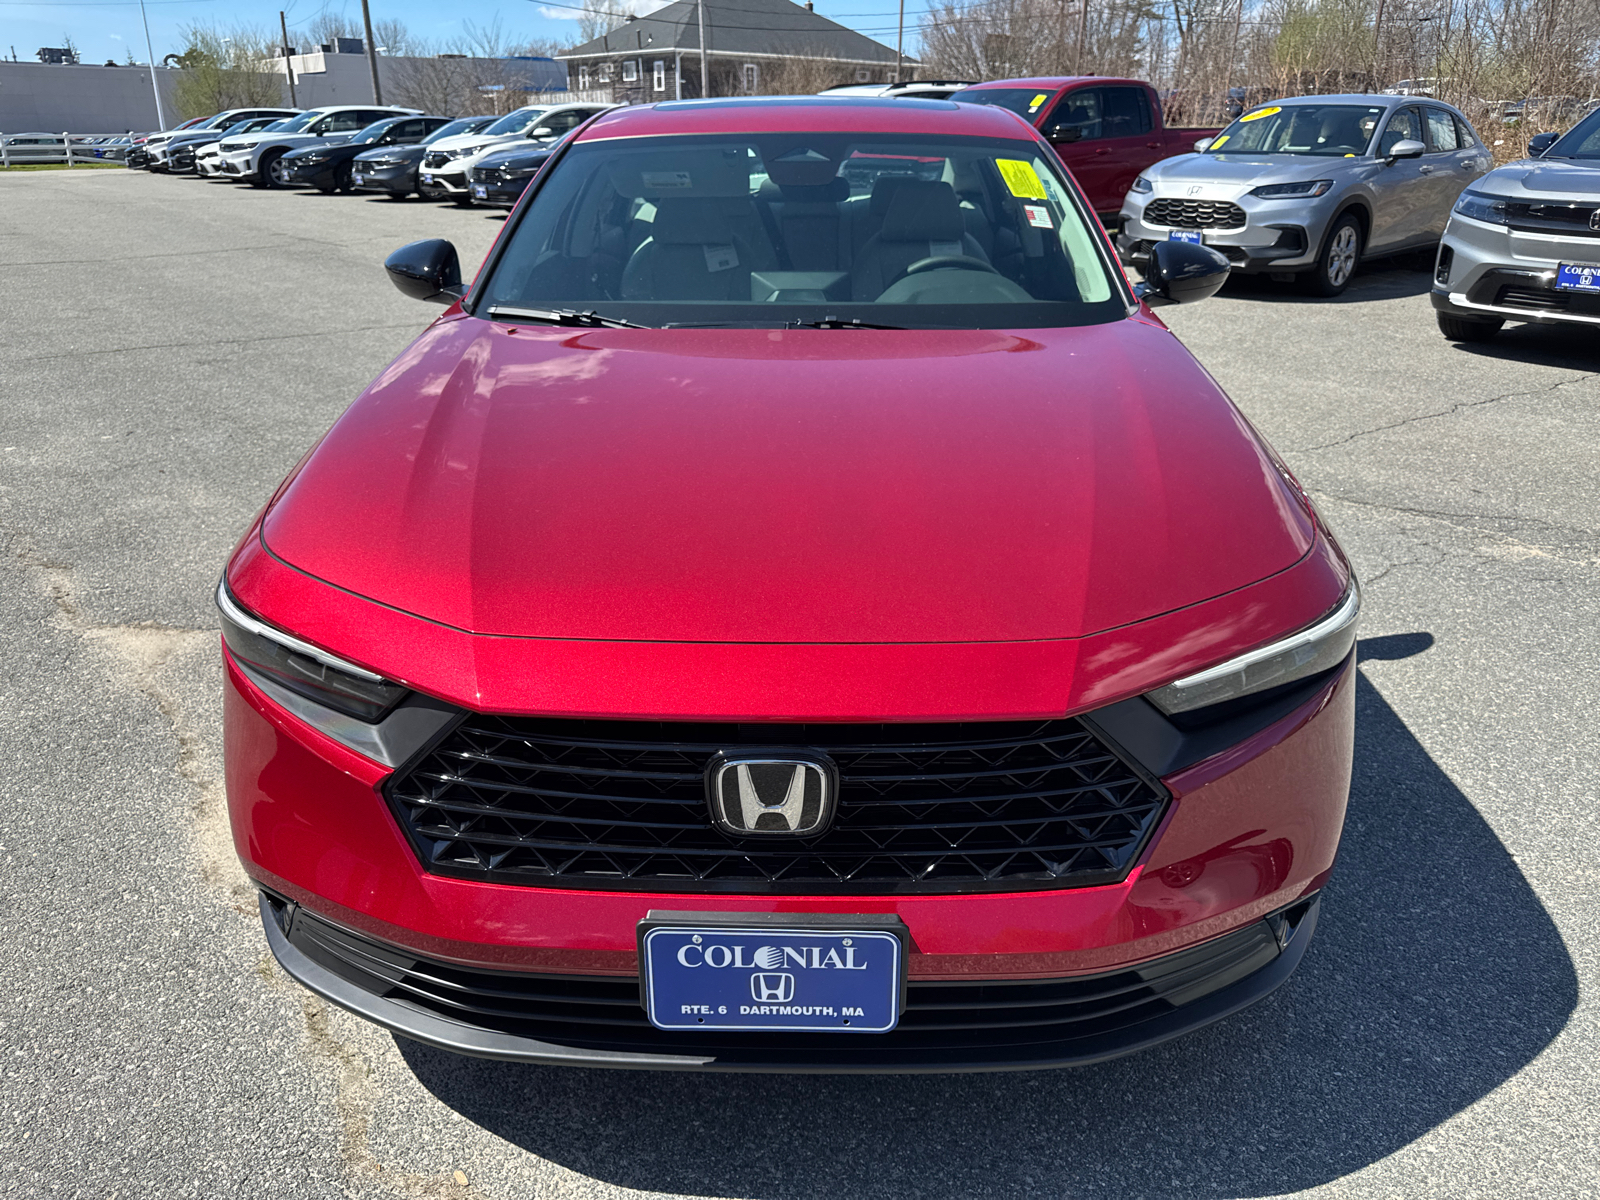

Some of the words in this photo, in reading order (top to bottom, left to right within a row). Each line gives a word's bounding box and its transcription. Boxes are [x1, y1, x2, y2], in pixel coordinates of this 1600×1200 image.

[677, 944, 868, 970] COLONIAL
[681, 1005, 714, 1015] RTE.
[718, 1005, 728, 1015] 6
[740, 1006, 838, 1018] DARTMOUTH,
[842, 1007, 865, 1017] MA
